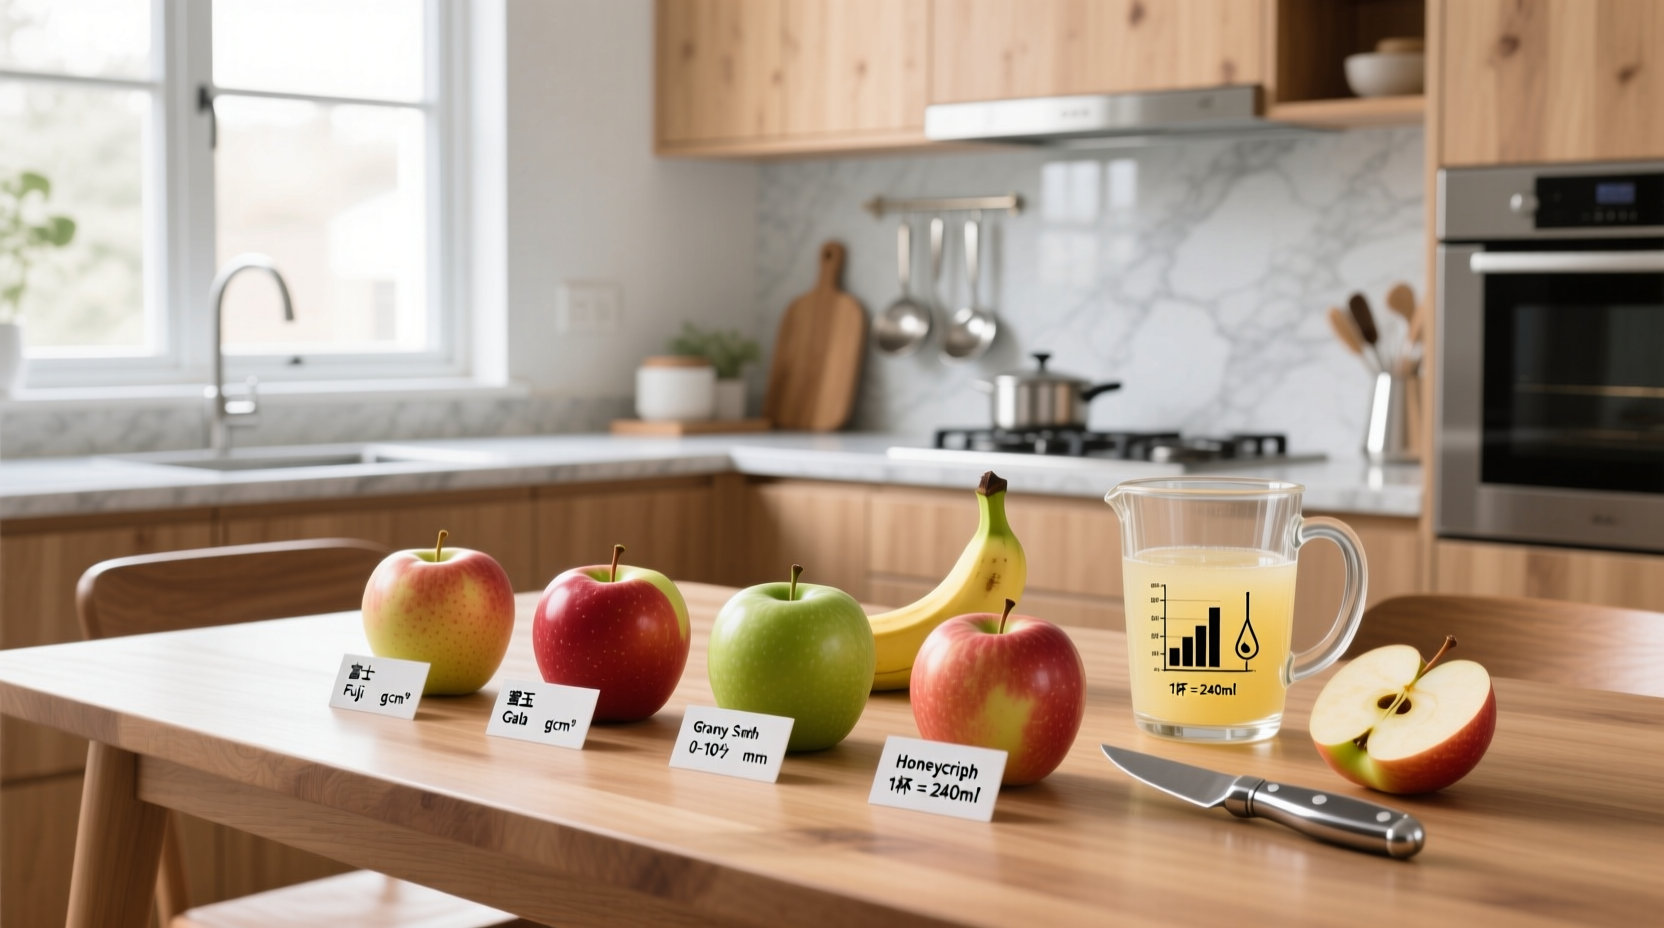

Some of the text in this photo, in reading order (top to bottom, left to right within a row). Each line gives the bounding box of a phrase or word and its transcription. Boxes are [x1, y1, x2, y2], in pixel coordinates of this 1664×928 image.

[343, 683, 365, 702] Fuji
[1199, 682, 1237, 696] 240ml
[742, 752, 768, 765] mm
[929, 782, 981, 803] 240ml
